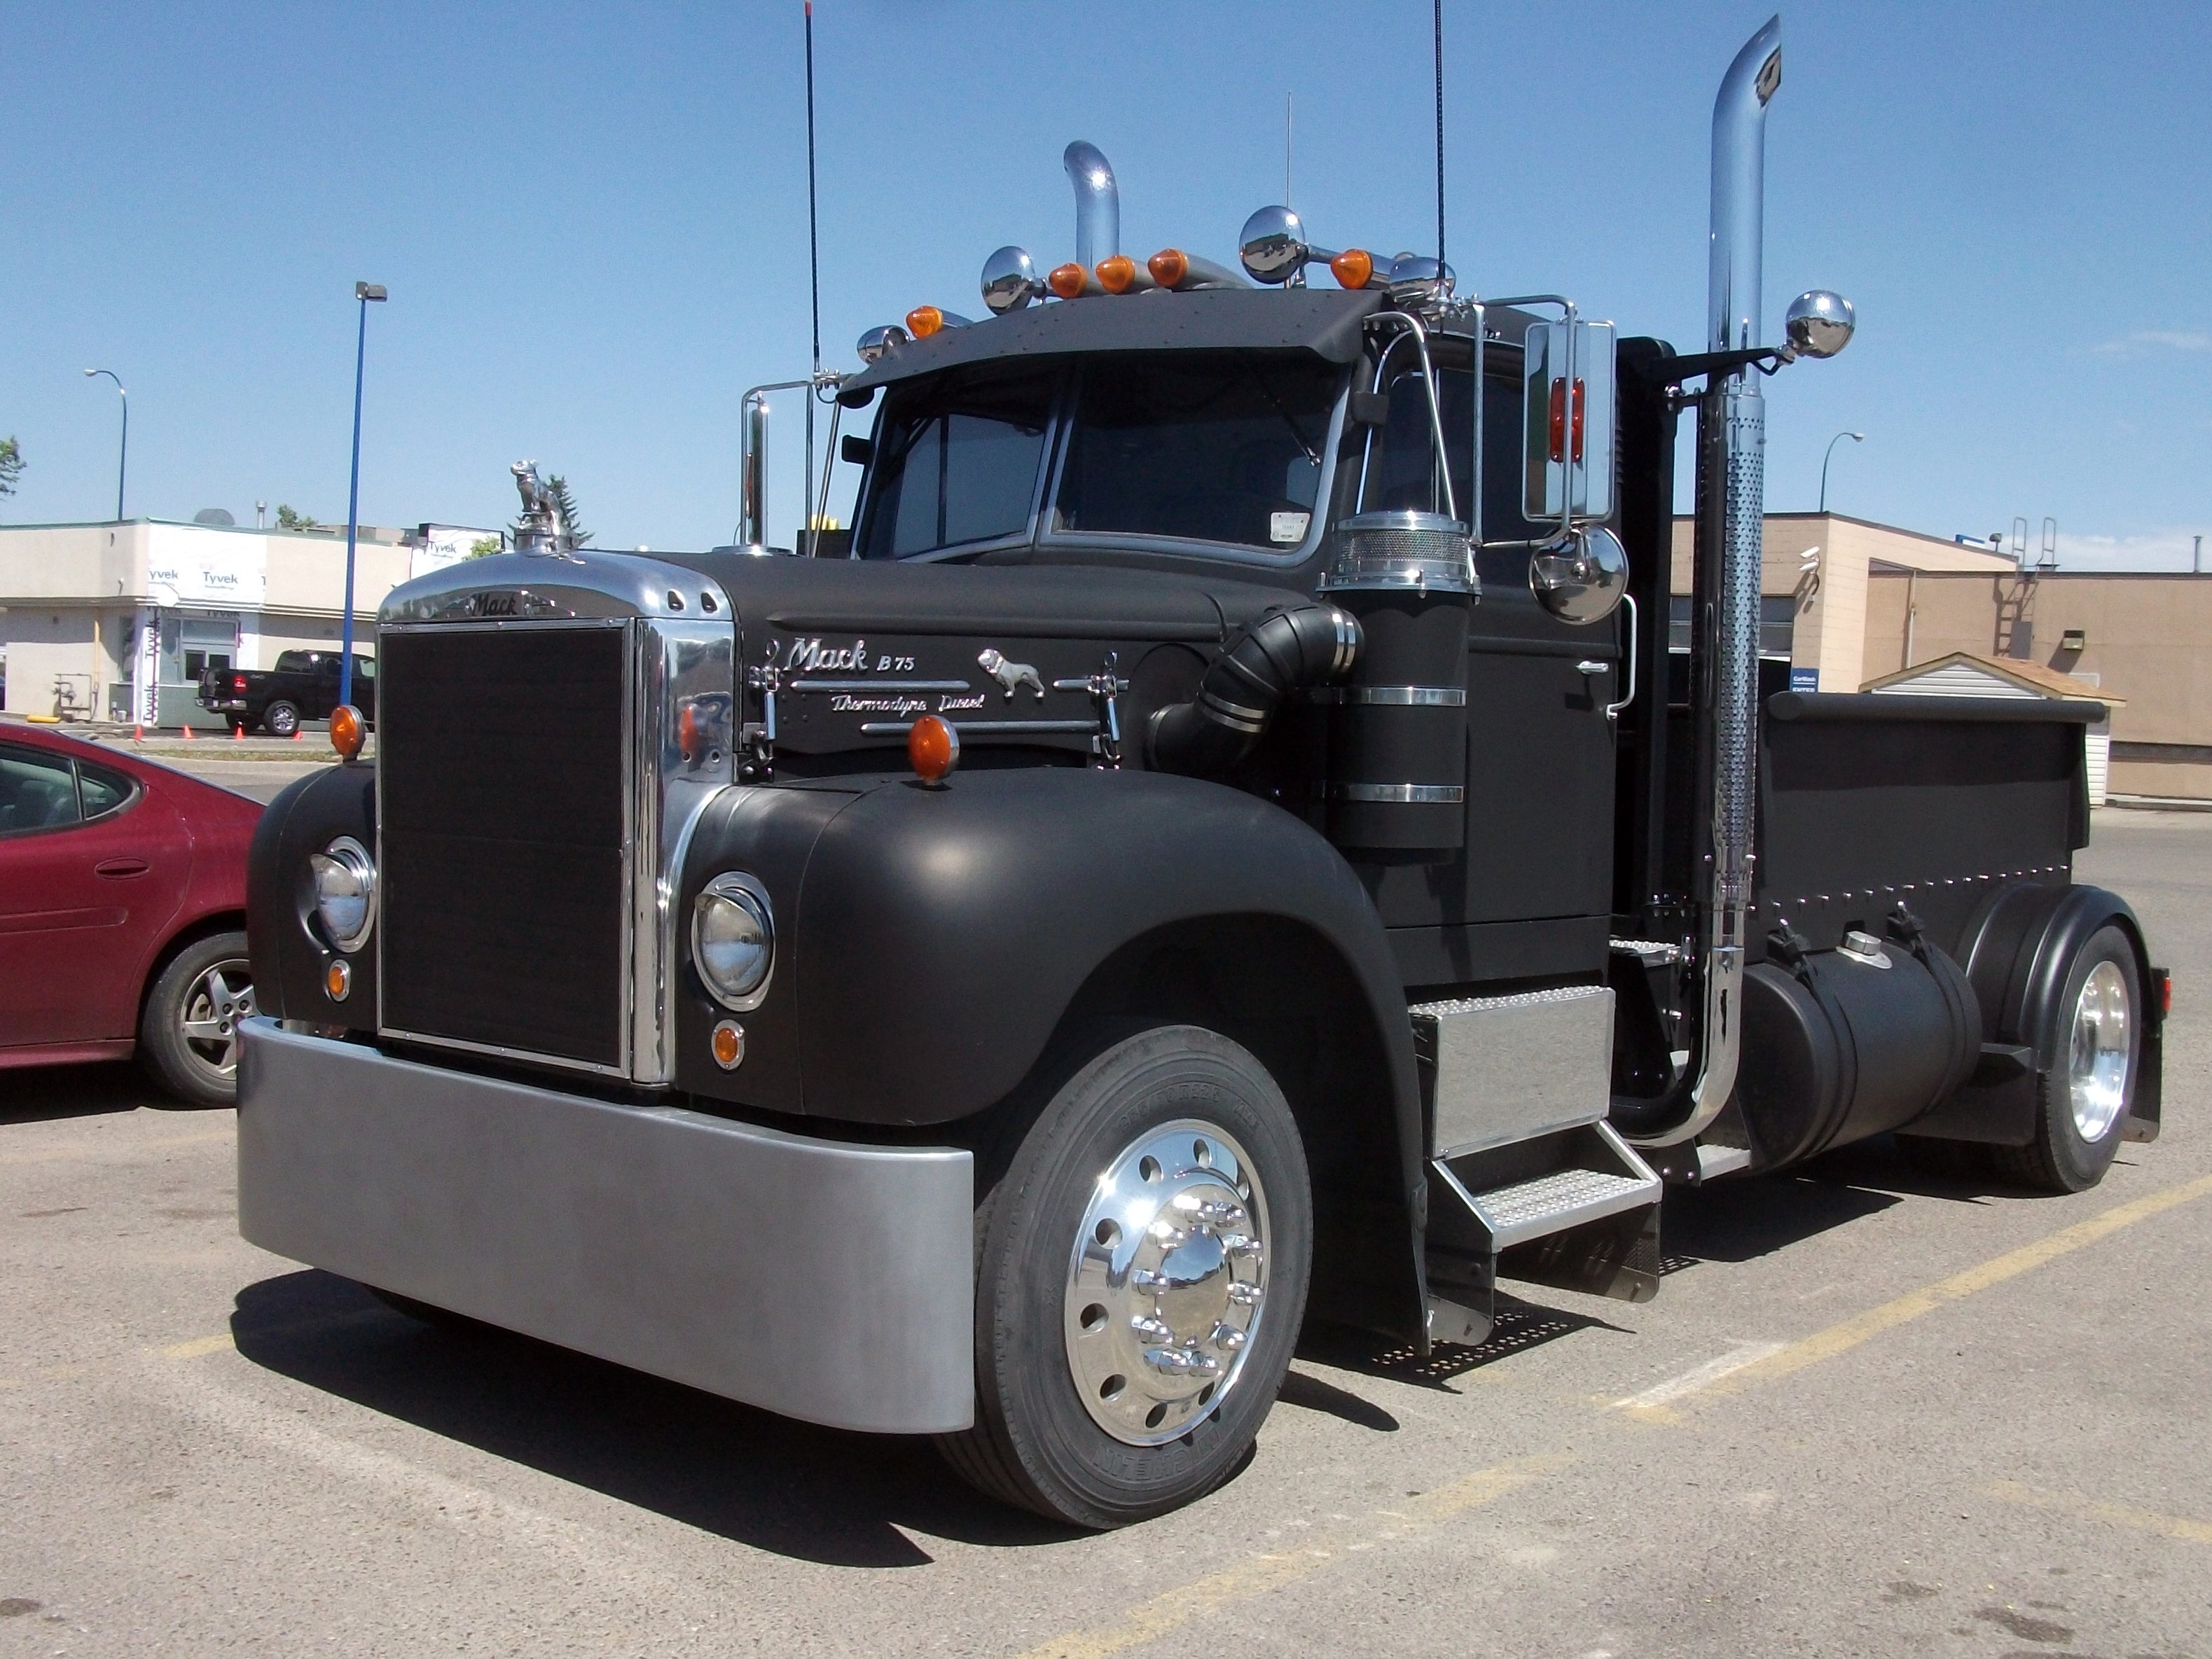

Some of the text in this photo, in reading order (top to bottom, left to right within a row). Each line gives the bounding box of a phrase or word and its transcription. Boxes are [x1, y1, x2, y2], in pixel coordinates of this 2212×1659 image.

[428, 541, 456, 553] Tyvek
[148, 569, 179, 580] yvek
[203, 571, 238, 584] Tyvek
[472, 593, 517, 616] Mack
[782, 637, 869, 671] Mack
[831, 694, 986, 719] Thermodyne Diesel
